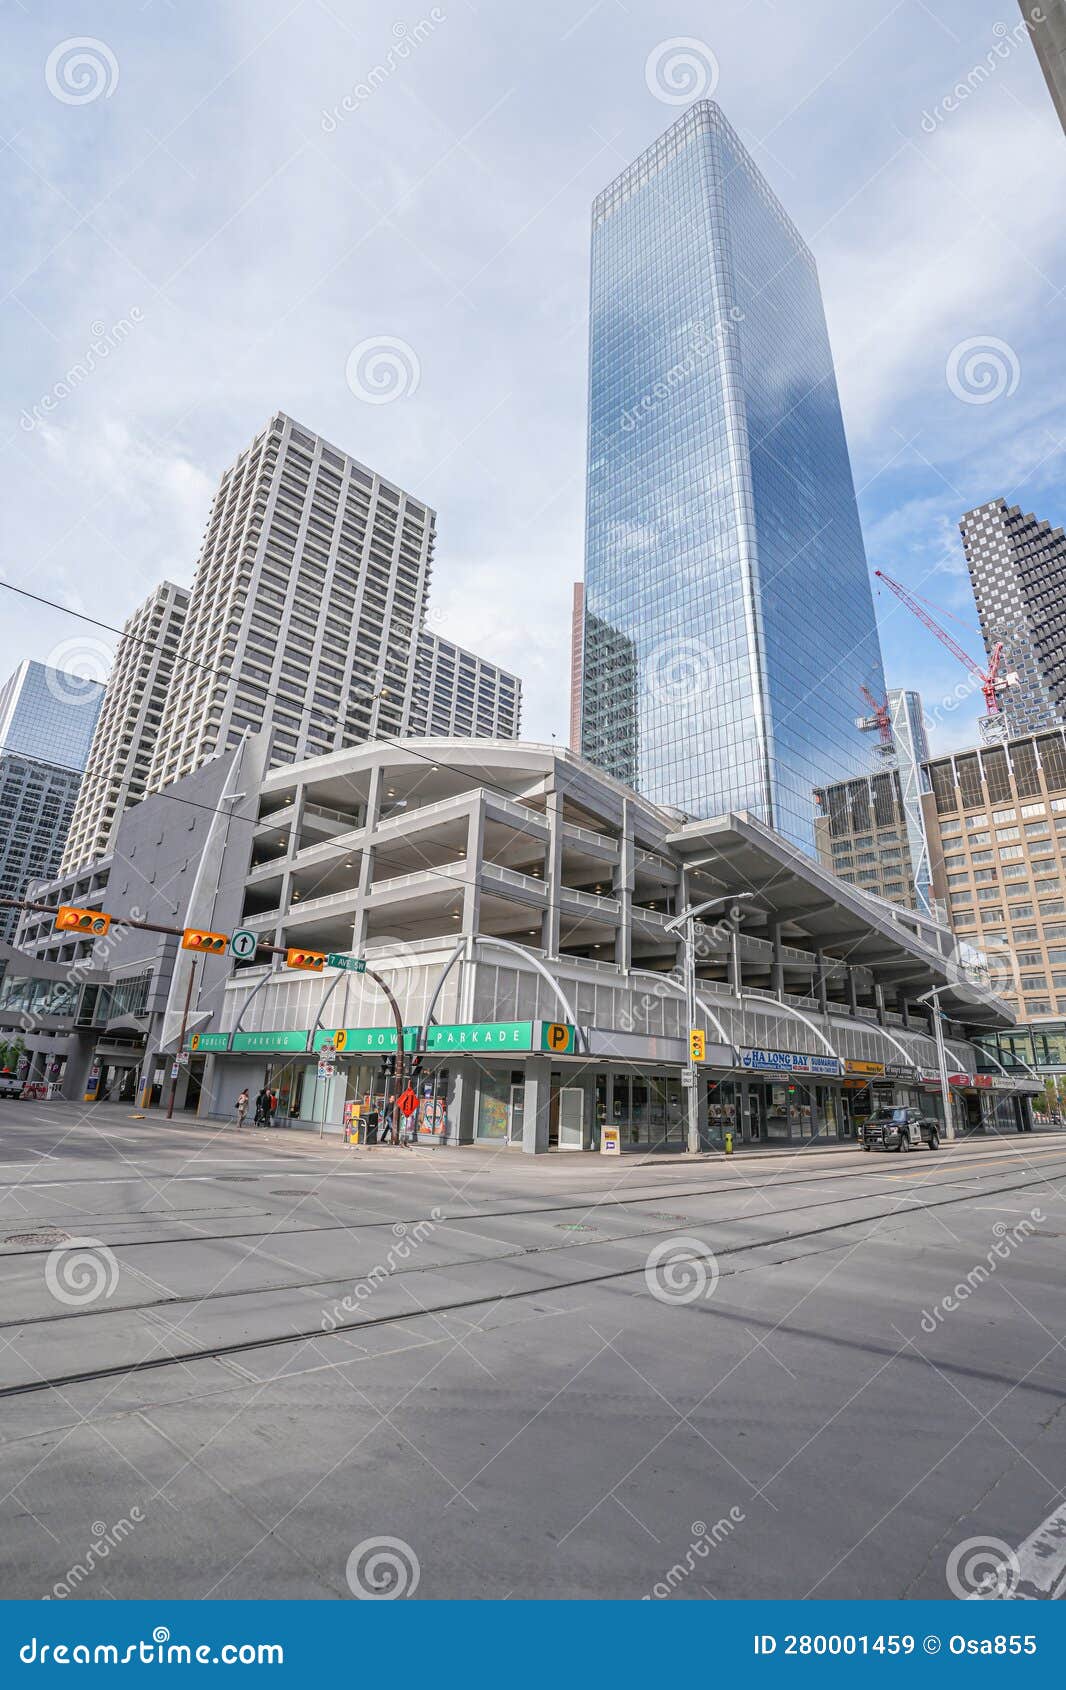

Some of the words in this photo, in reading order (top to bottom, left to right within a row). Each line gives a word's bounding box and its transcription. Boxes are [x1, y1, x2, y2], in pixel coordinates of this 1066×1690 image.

[330, 956, 336, 965] 7
[338, 958, 351, 969] AVE
[354, 960, 365, 971] SW
[193, 1035, 199, 1049] P
[202, 1038, 226, 1046] PUBLIC
[247, 1036, 289, 1046] PARKING
[336, 1032, 344, 1048] P
[367, 1034, 398, 1045] BOW
[436, 1030, 520, 1043] PARKADE
[553, 1026, 565, 1048] P
[752, 1050, 765, 1062] HA
[768, 1052, 791, 1064] LONG
[792, 1055, 808, 1066] BAY
